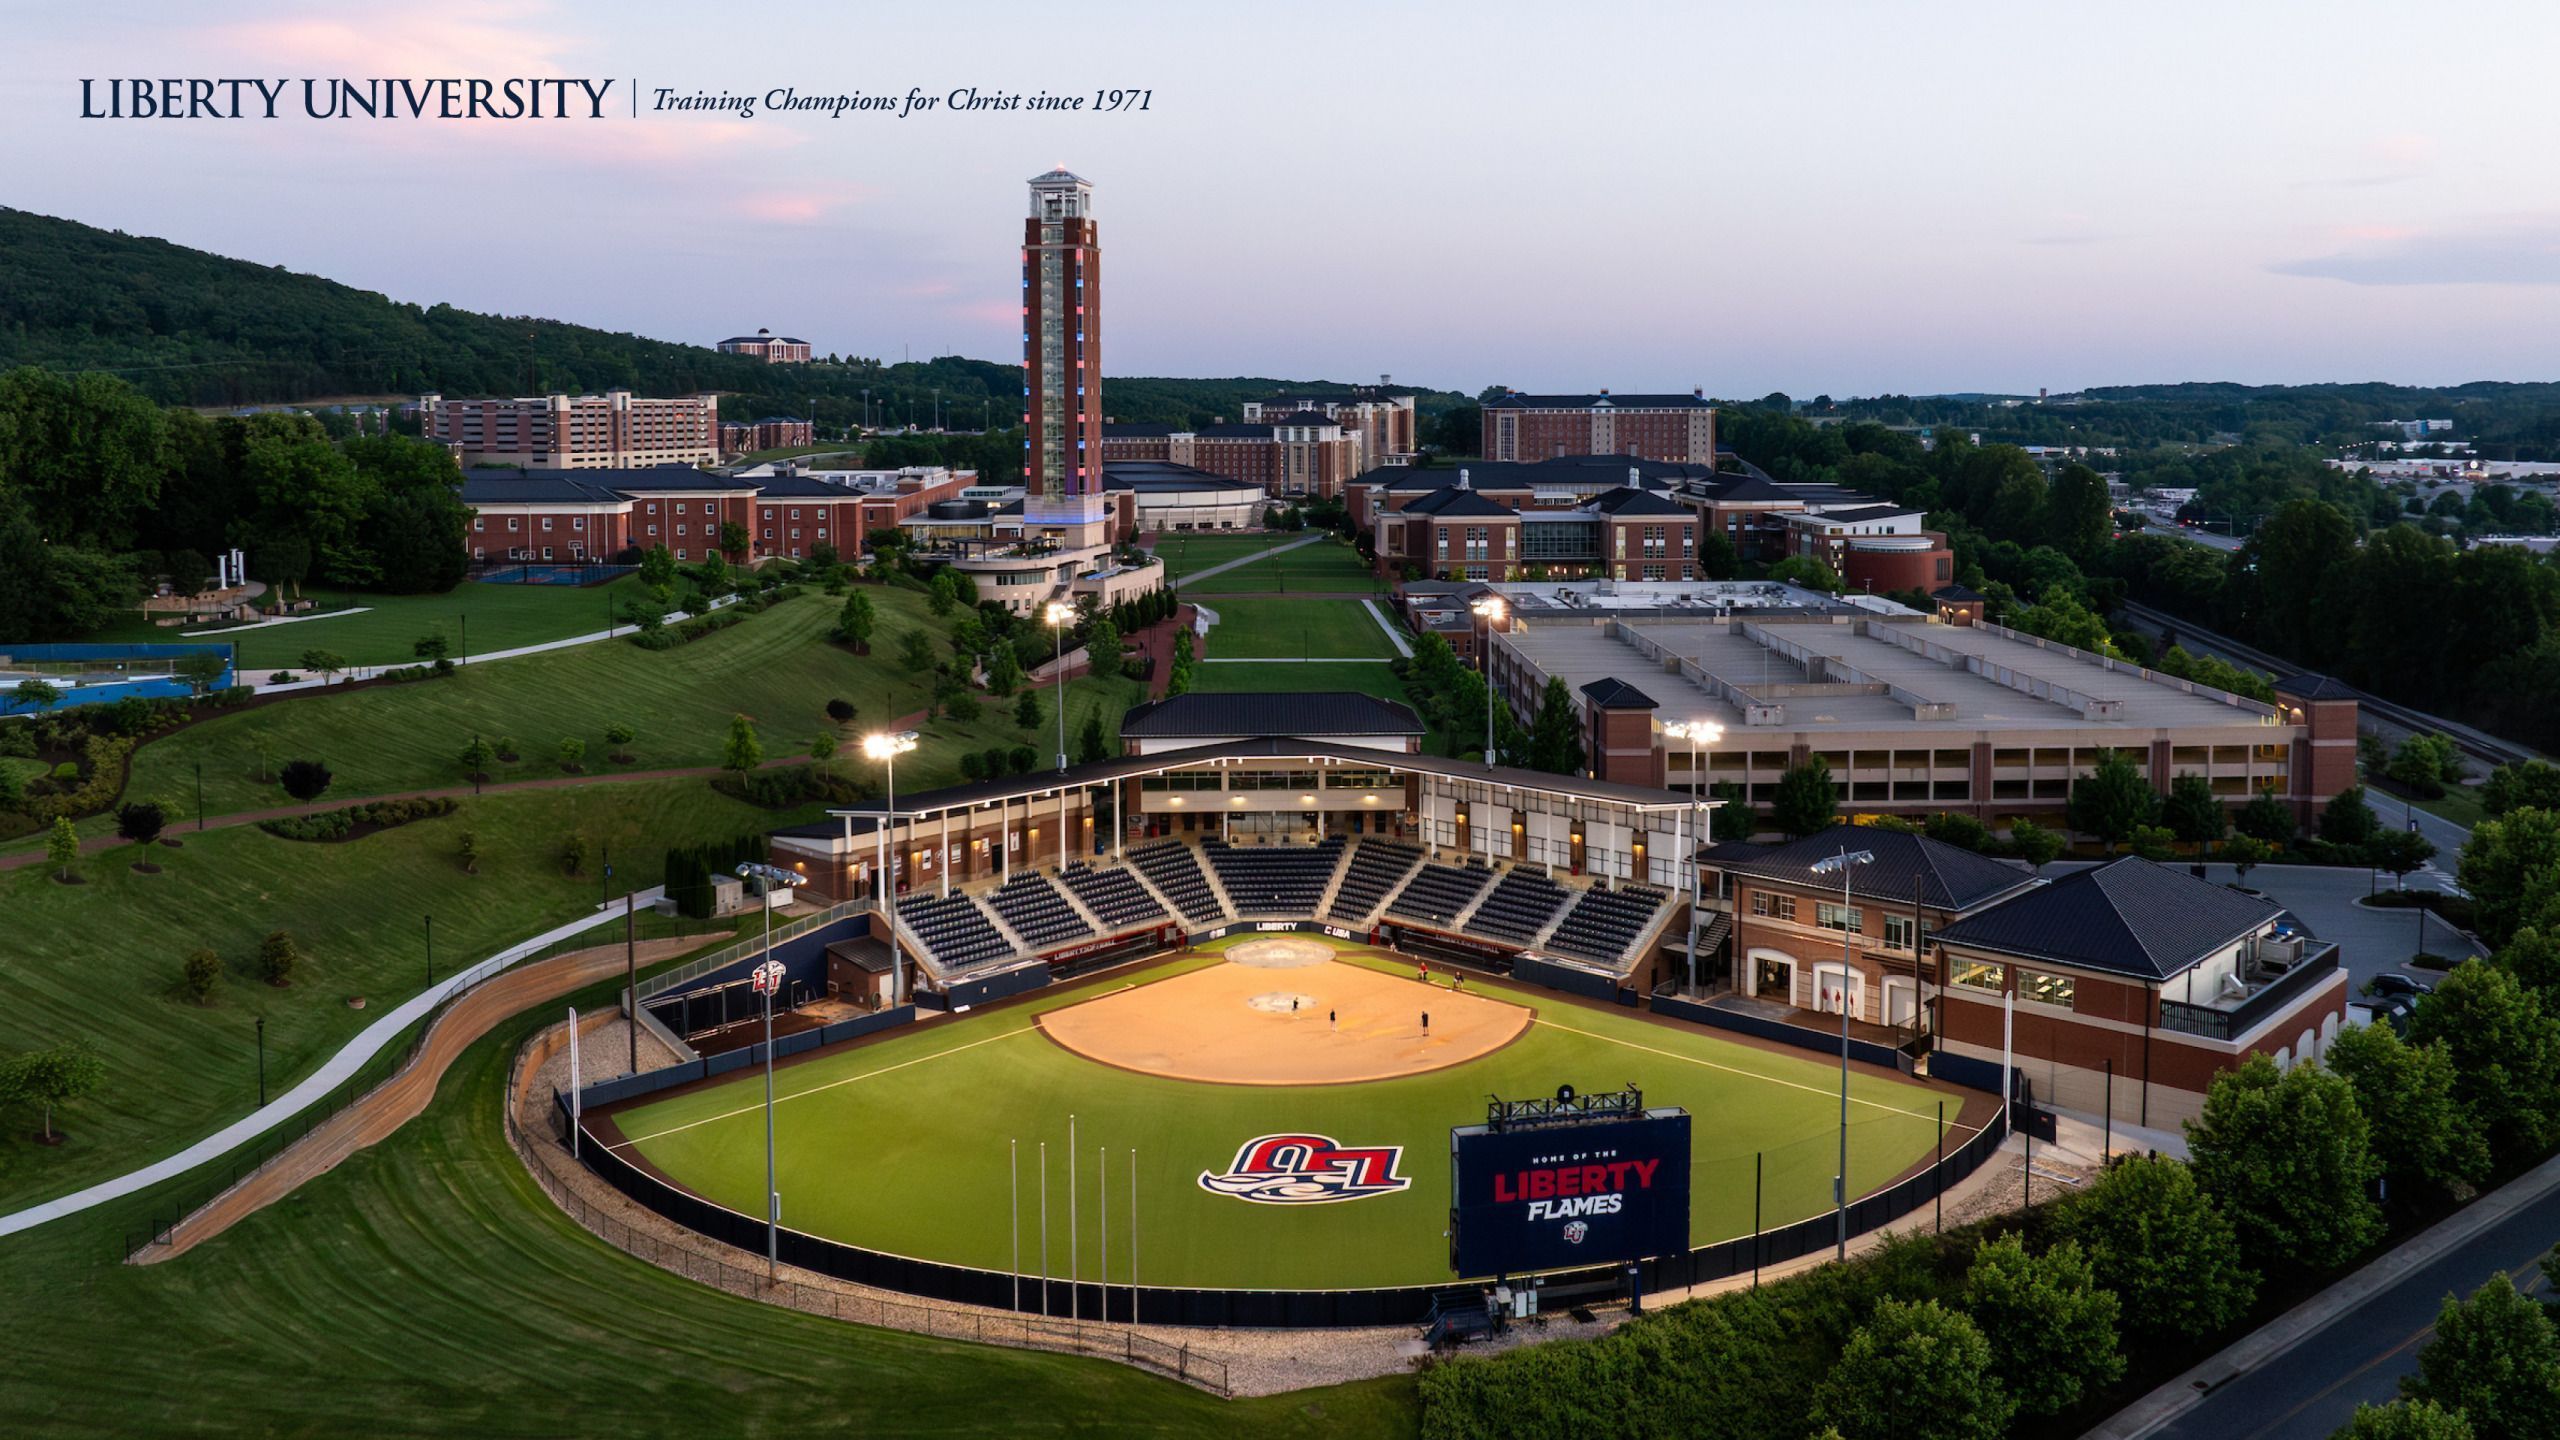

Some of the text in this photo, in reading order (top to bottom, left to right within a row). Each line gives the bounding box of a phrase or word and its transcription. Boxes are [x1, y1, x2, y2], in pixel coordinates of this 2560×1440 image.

[1256, 922, 1298, 931] LIBERTY
[1532, 1149, 1617, 1165] HOME OF THE
[1494, 1158, 1660, 1203] LIBERTY
[1527, 1193, 1622, 1222] FLAMES
